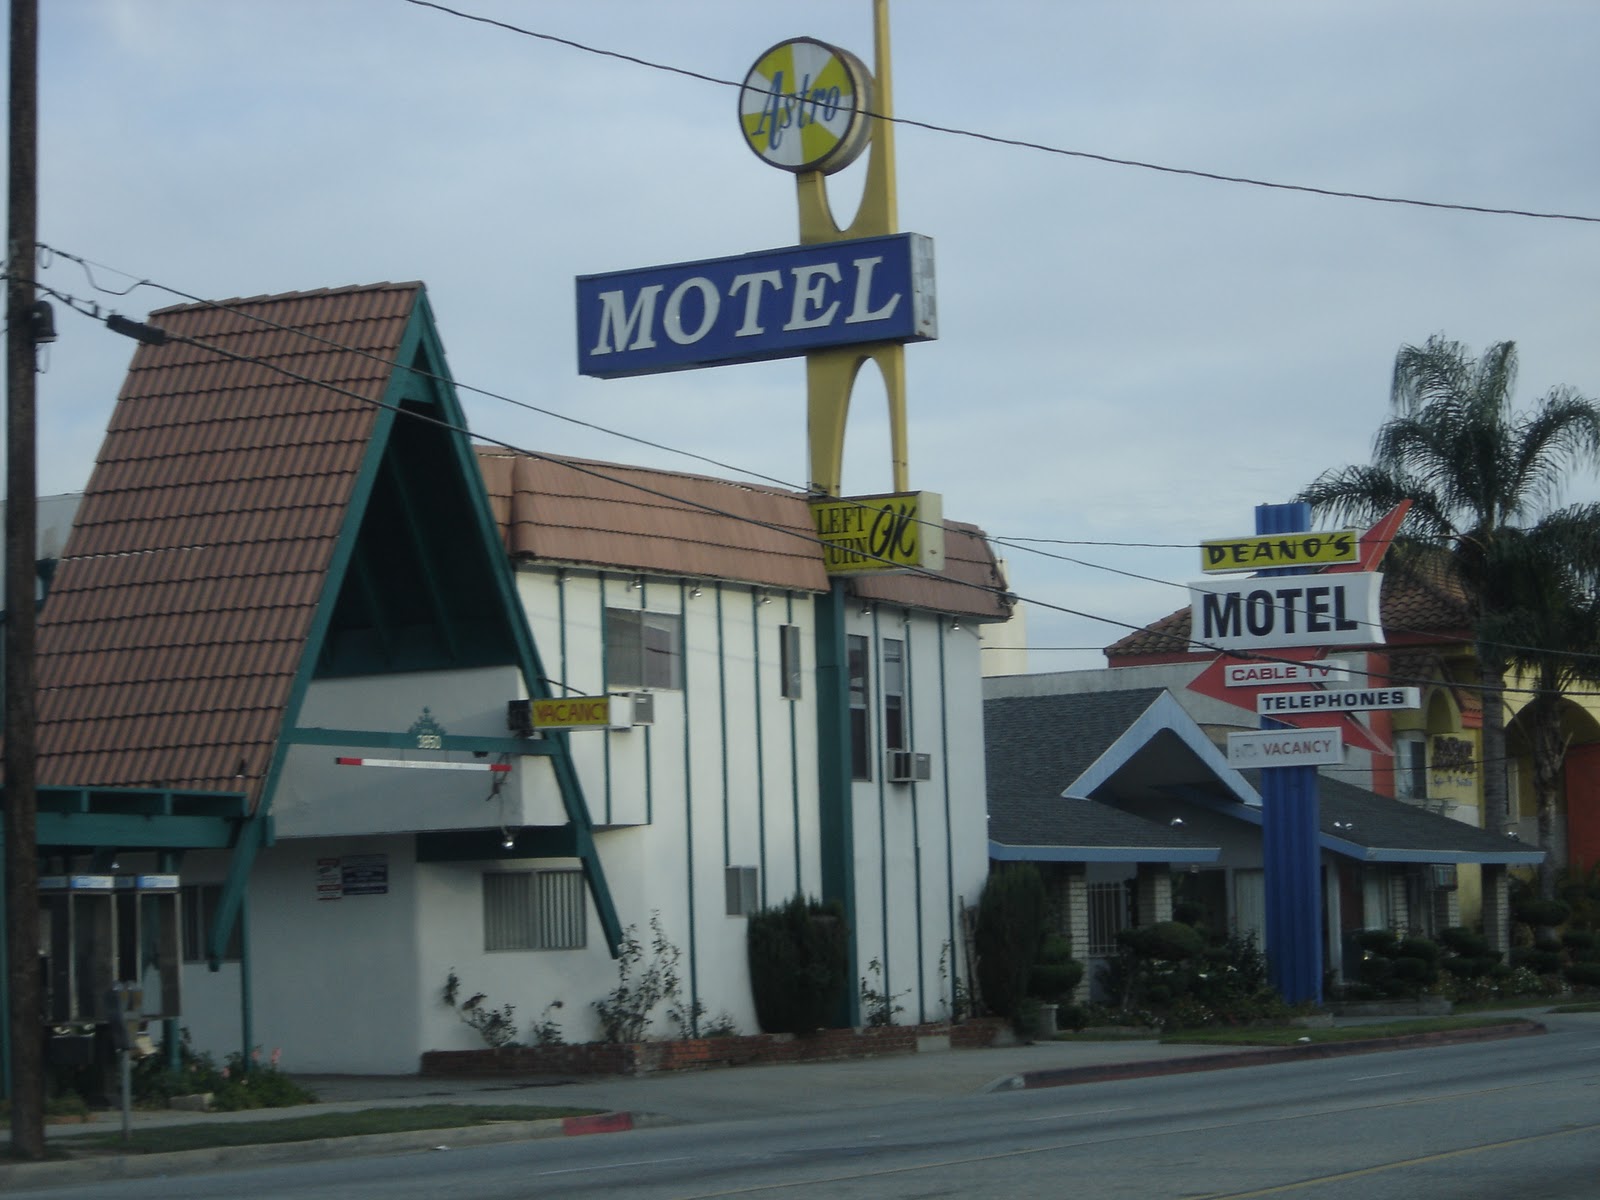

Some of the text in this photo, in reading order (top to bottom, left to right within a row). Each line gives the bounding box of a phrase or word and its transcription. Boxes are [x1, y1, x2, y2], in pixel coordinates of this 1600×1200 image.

[752, 71, 840, 150] Astro
[590, 256, 902, 356] MOTEL
[816, 505, 867, 535] LEFT
[869, 503, 917, 560] OK
[1207, 534, 1351, 565] DEANO'S
[1203, 586, 1358, 639] MOTEL
[1231, 664, 1334, 682] CABLE TV
[1262, 690, 1405, 711] TELEPHONES
[1263, 739, 1332, 757] VACANCY
